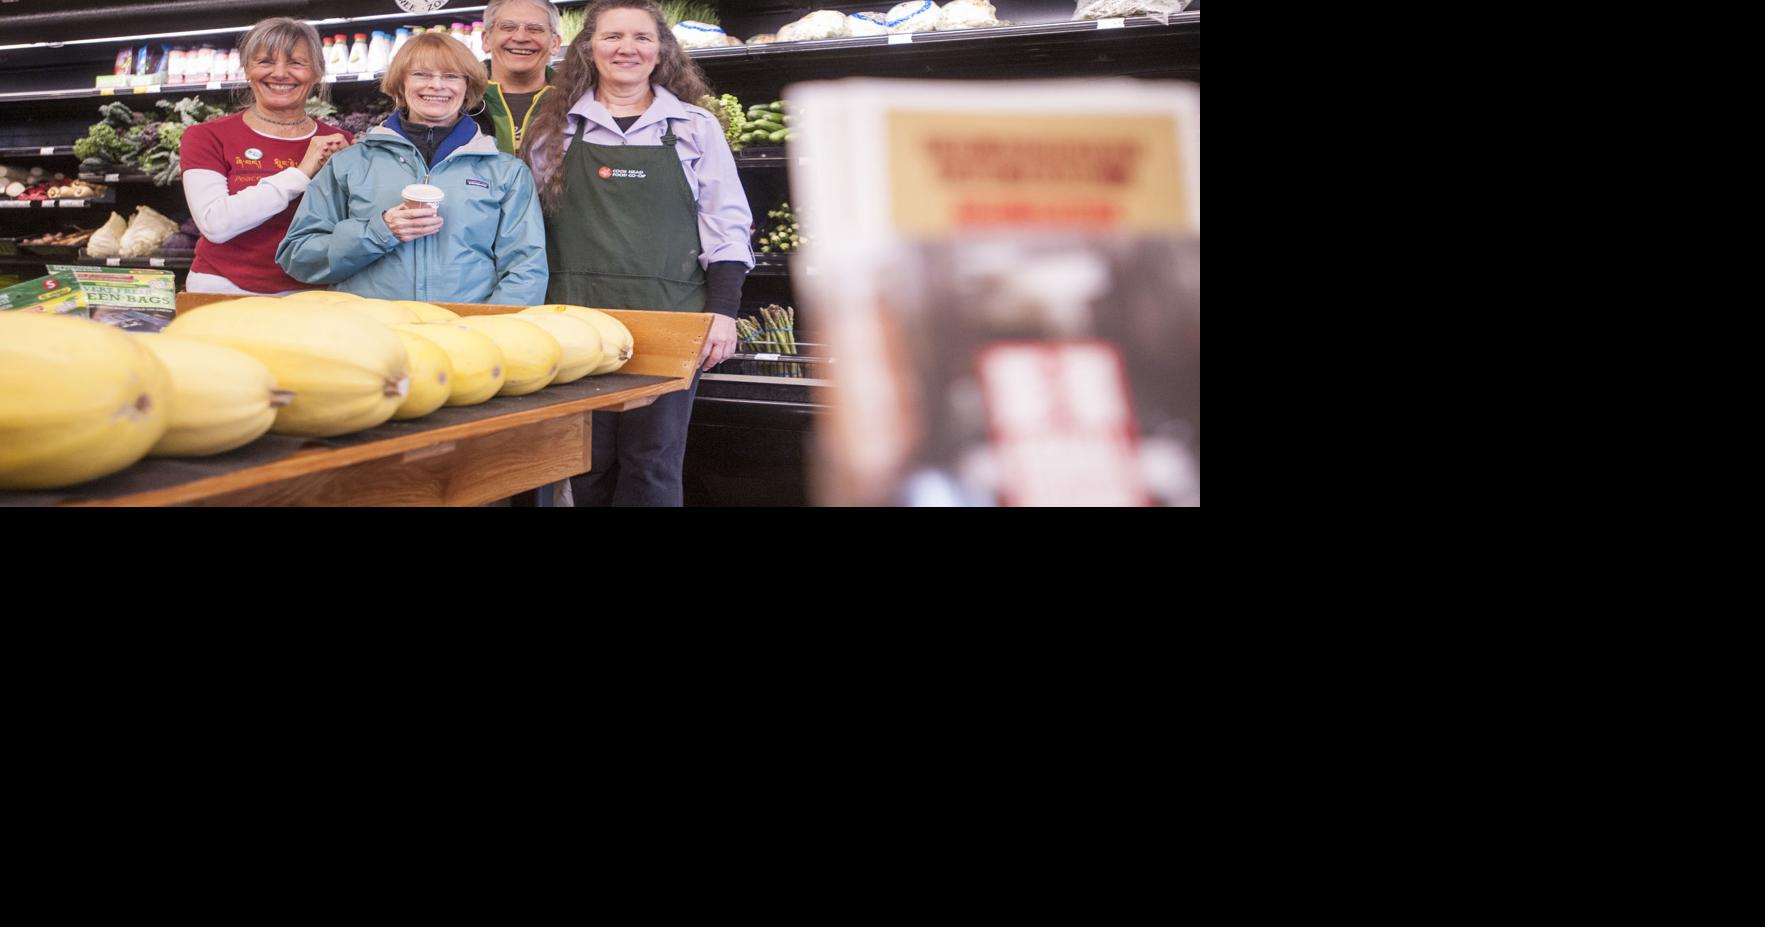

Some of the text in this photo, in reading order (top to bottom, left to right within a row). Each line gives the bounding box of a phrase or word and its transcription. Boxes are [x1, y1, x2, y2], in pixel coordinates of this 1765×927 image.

[46, 280, 56, 290] S
[87, 292, 170, 304] EEN BAGS
